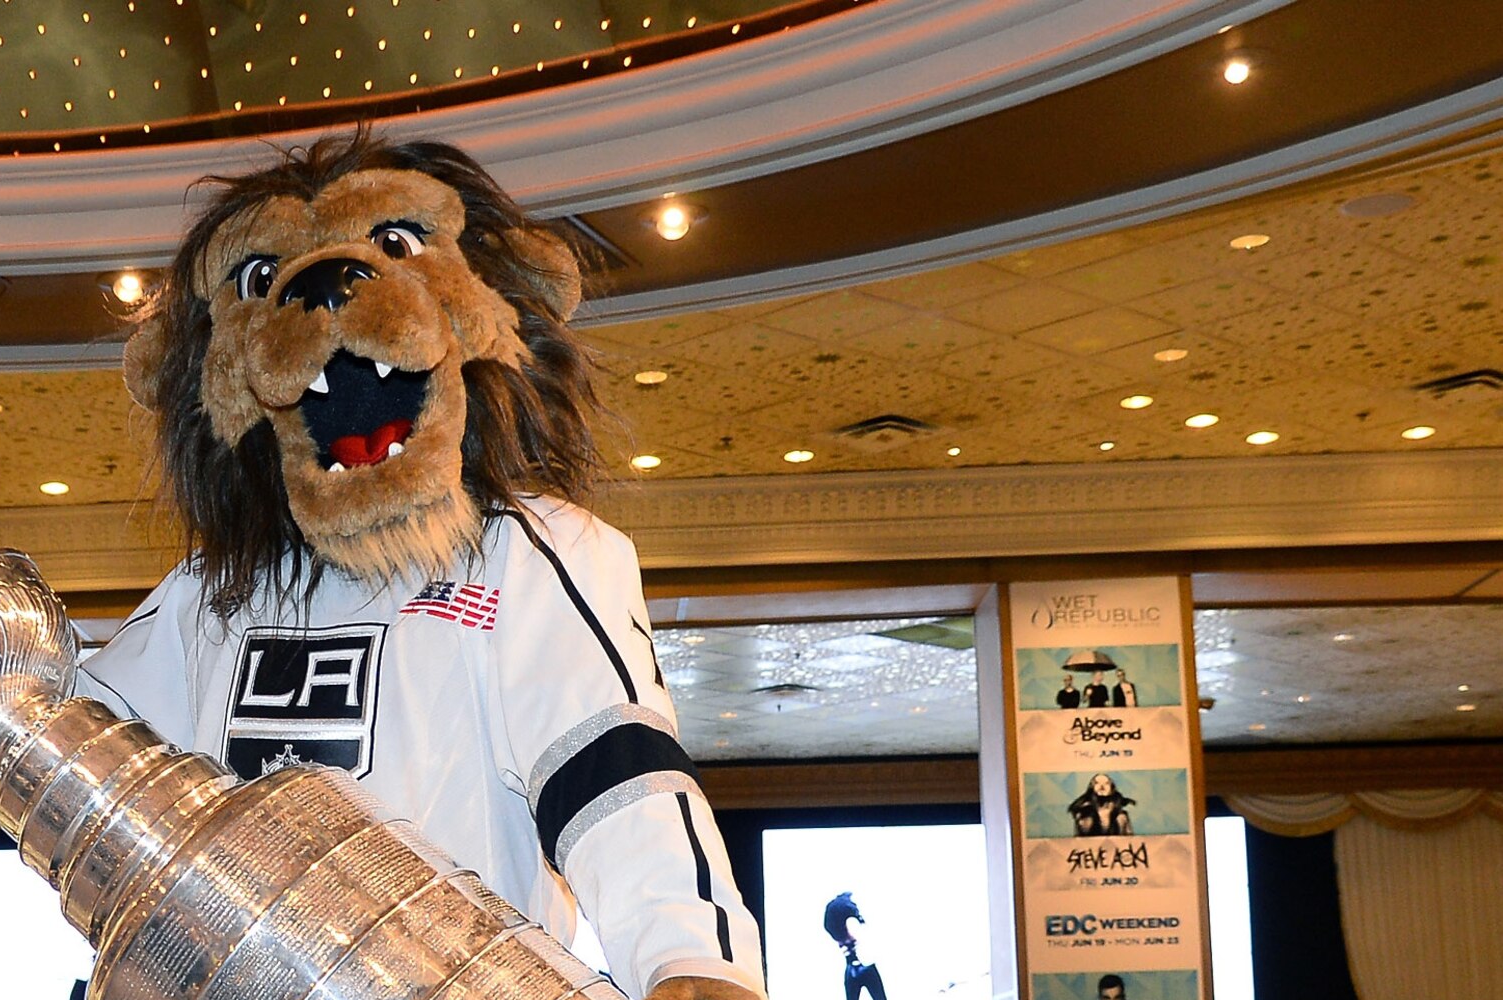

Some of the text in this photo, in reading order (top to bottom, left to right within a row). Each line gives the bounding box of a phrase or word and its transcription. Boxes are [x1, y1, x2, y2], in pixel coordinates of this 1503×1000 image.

[1052, 594, 1098, 609] WET
[1054, 607, 1160, 624] REPUBLIC
[240, 647, 366, 708] LA
[1071, 717, 1123, 731] Above
[1081, 728, 1141, 744] Beyond
[1067, 848, 1109, 873] STEVE
[1101, 877, 1122, 886] JUN
[1125, 876, 1139, 886] 20
[1045, 914, 1179, 936] EDC WEEKEND
[1047, 939, 1068, 948] THU
[1072, 938, 1092, 948] JUN
[1115, 938, 1140, 947] MON
[1144, 936, 1164, 946] JUN
